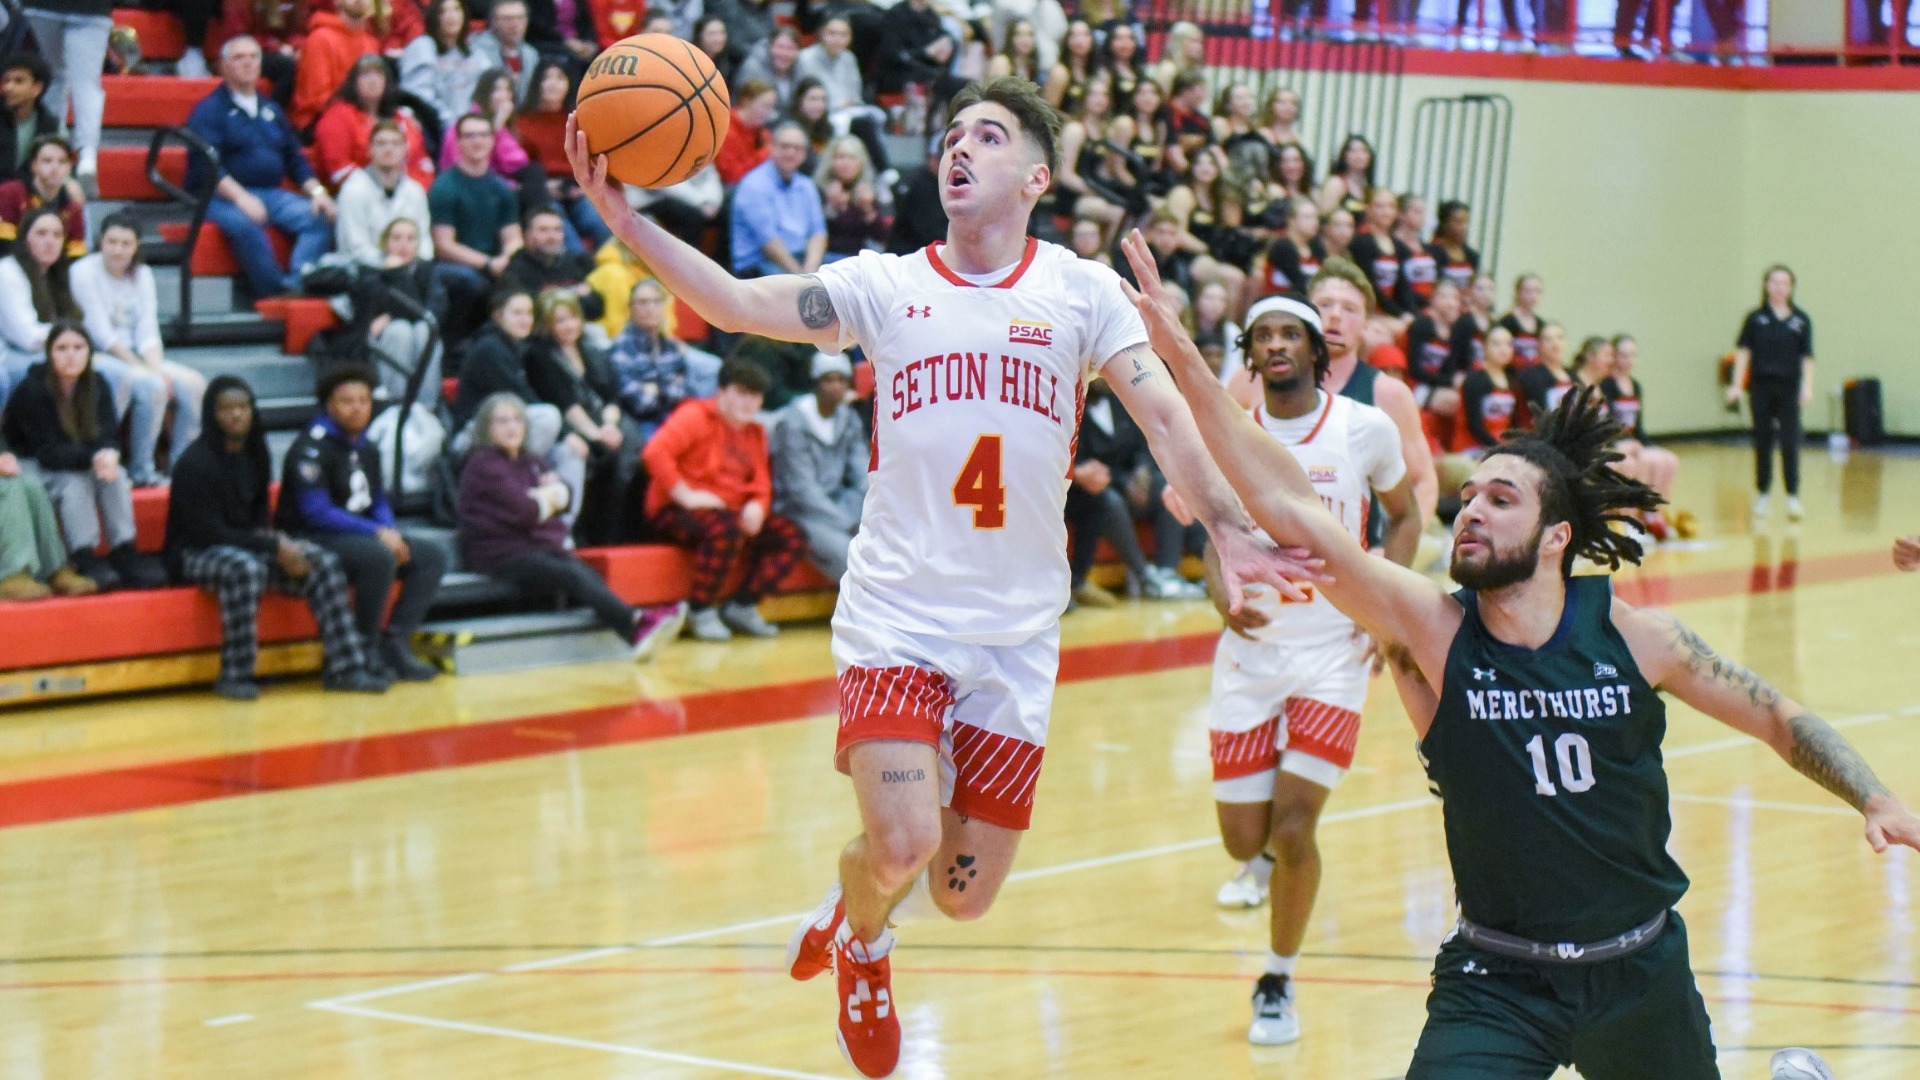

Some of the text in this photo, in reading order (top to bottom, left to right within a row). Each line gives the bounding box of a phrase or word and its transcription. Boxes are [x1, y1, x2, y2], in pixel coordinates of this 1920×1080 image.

[1009, 325, 1053, 341] PSAC
[892, 352, 1061, 426] SETON HILL
[951, 433, 1006, 530] 4
[1466, 684, 1631, 720] MERCYHURST
[882, 768, 926, 783] DMGB
[1525, 732, 1596, 796] 10
